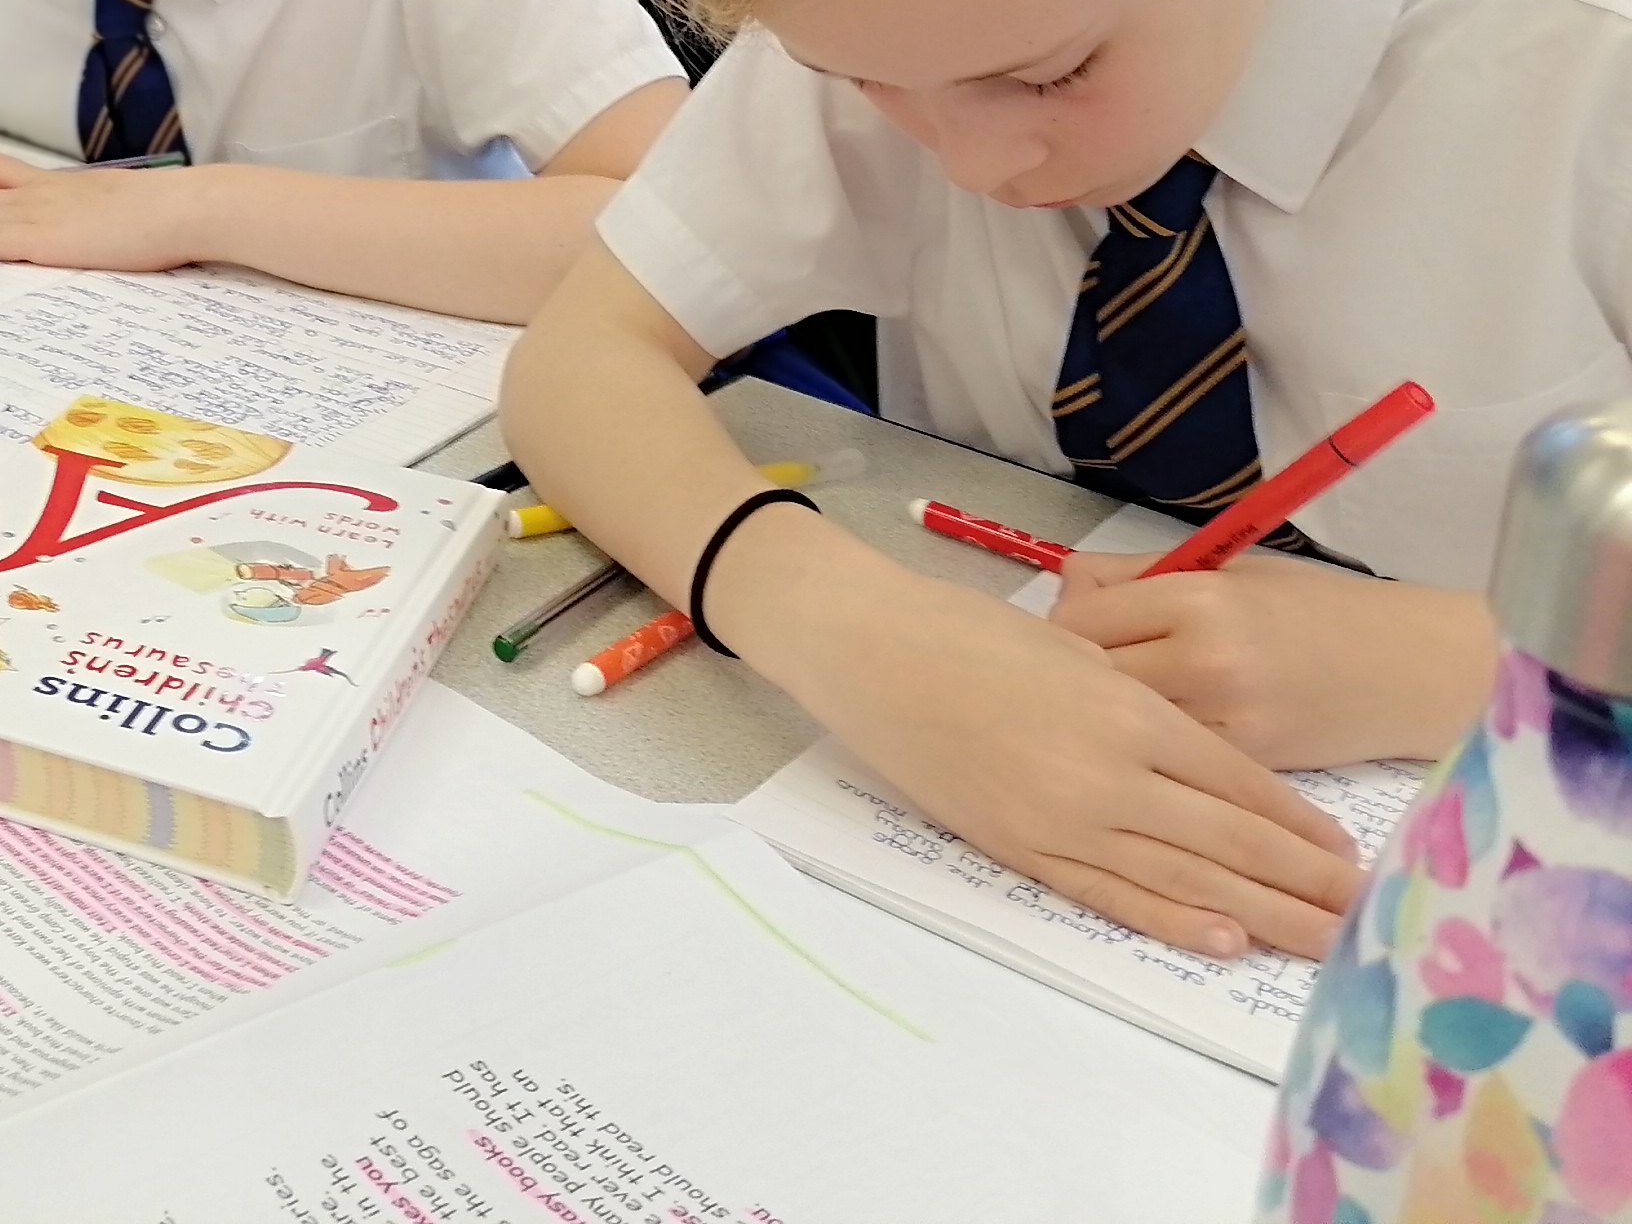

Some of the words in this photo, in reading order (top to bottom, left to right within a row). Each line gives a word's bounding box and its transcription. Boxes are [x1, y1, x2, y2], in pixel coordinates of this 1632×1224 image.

[250, 508, 307, 527] with
[317, 525, 395, 548] Learn
[324, 512, 401, 535] words
[60, 650, 275, 721] Children's
[33, 676, 252, 752] Collins
[945, 863, 994, 889] the
[1131, 948, 1206, 987] start
[469, 1060, 509, 1098] has
[511, 1068, 539, 1093] an
[441, 1069, 513, 1133] should
[505, 1100, 536, 1125] It
[536, 1098, 586, 1138] that
[556, 1078, 601, 1121] this.
[375, 1109, 408, 1131] of
[369, 1135, 420, 1185] best
[406, 1134, 456, 1181] saga
[532, 1124, 593, 1172] read.
[585, 1138, 645, 1185] think
[596, 1122, 656, 1163] read
[321, 1154, 358, 1195] the
[355, 1155, 400, 1195] you
[473, 1136, 539, 1193] books
[511, 1135, 588, 1194] people
[357, 1196, 381, 1219] in
[418, 1184, 458, 1221] the
[454, 1183, 493, 1218] the
[589, 1175, 644, 1212] ever
[641, 1185, 665, 1203] I
[648, 1163, 731, 1219] should
